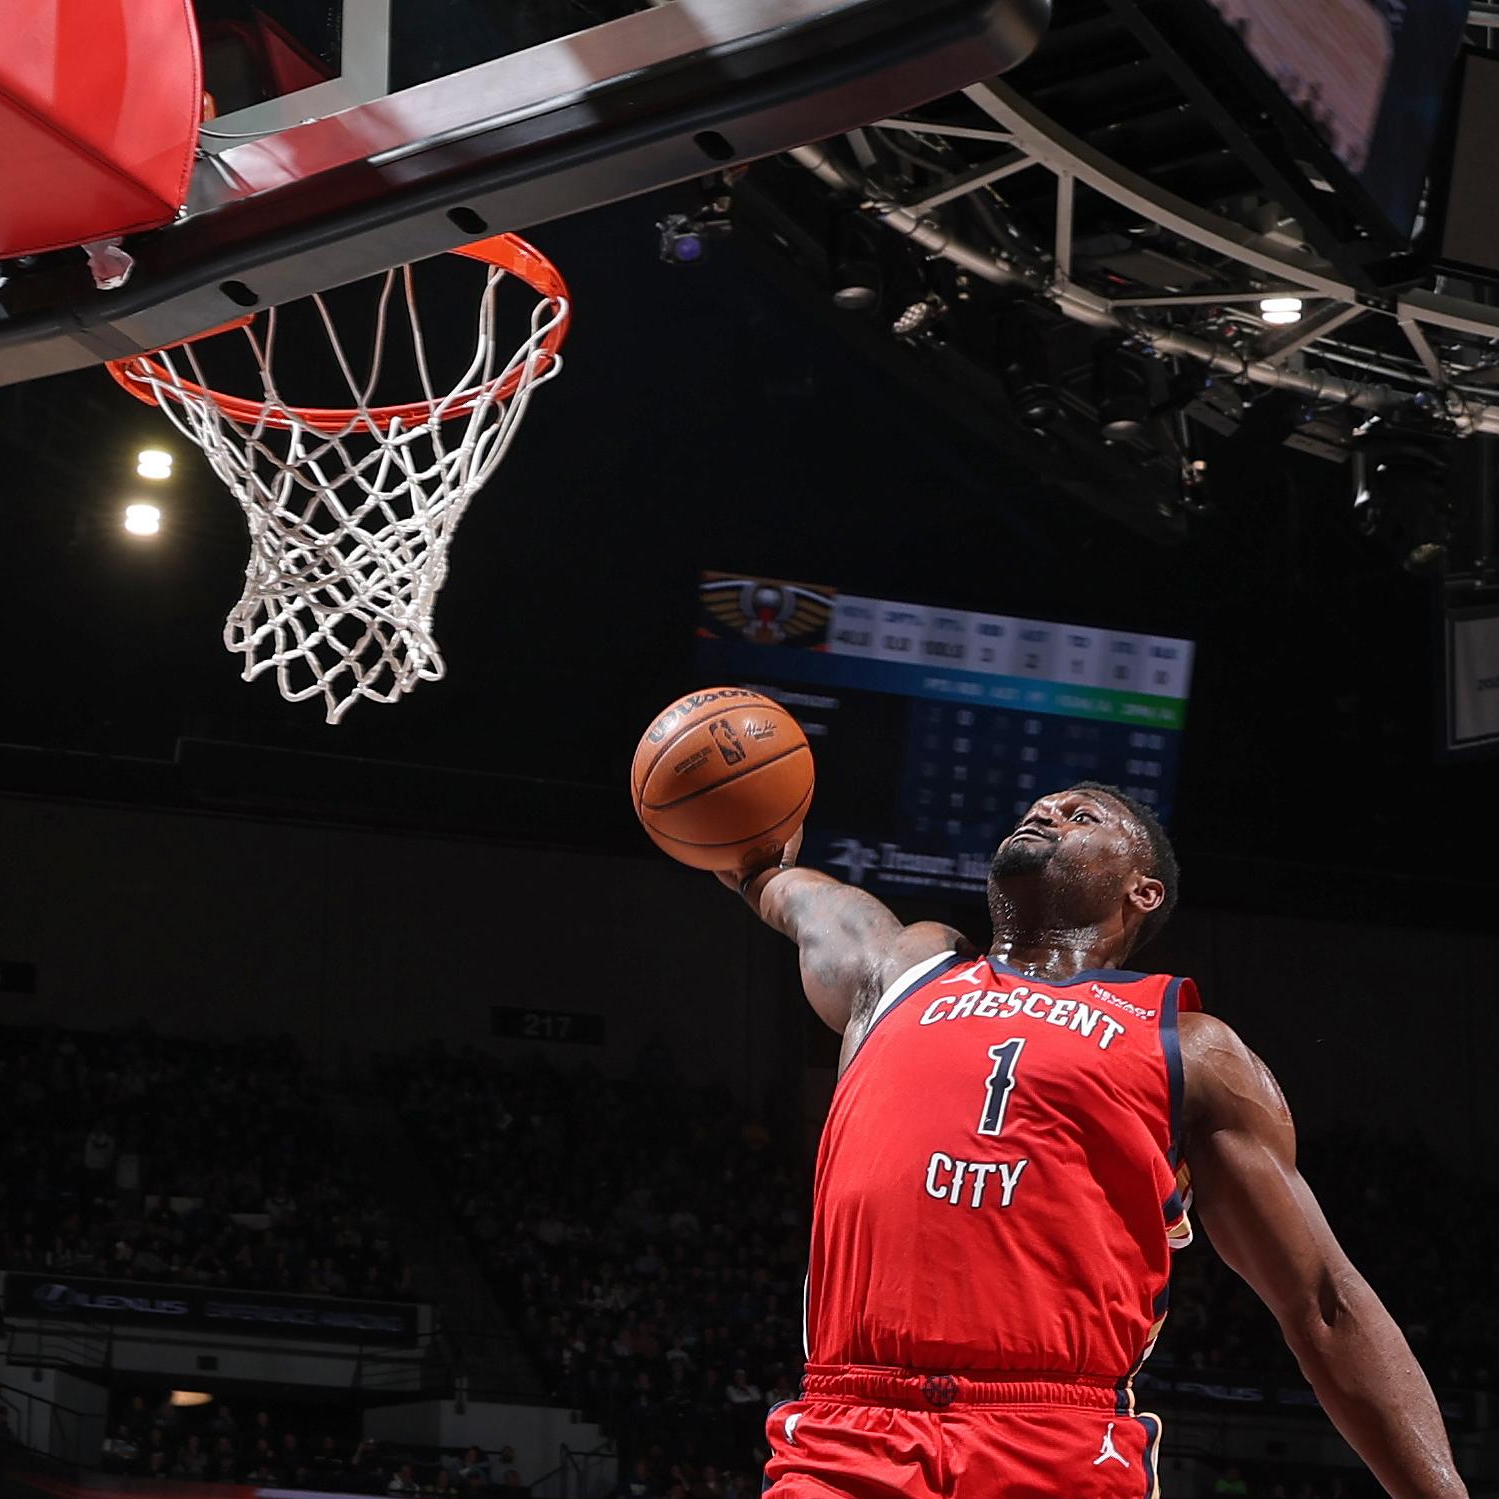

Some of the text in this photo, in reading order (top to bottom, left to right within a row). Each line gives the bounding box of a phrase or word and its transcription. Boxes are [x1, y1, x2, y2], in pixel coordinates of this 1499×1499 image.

[523, 1012, 574, 1039] 217
[919, 986, 1125, 1051] CRESCENT
[976, 1037, 1027, 1137] 1
[926, 1151, 1030, 1209] CITY
